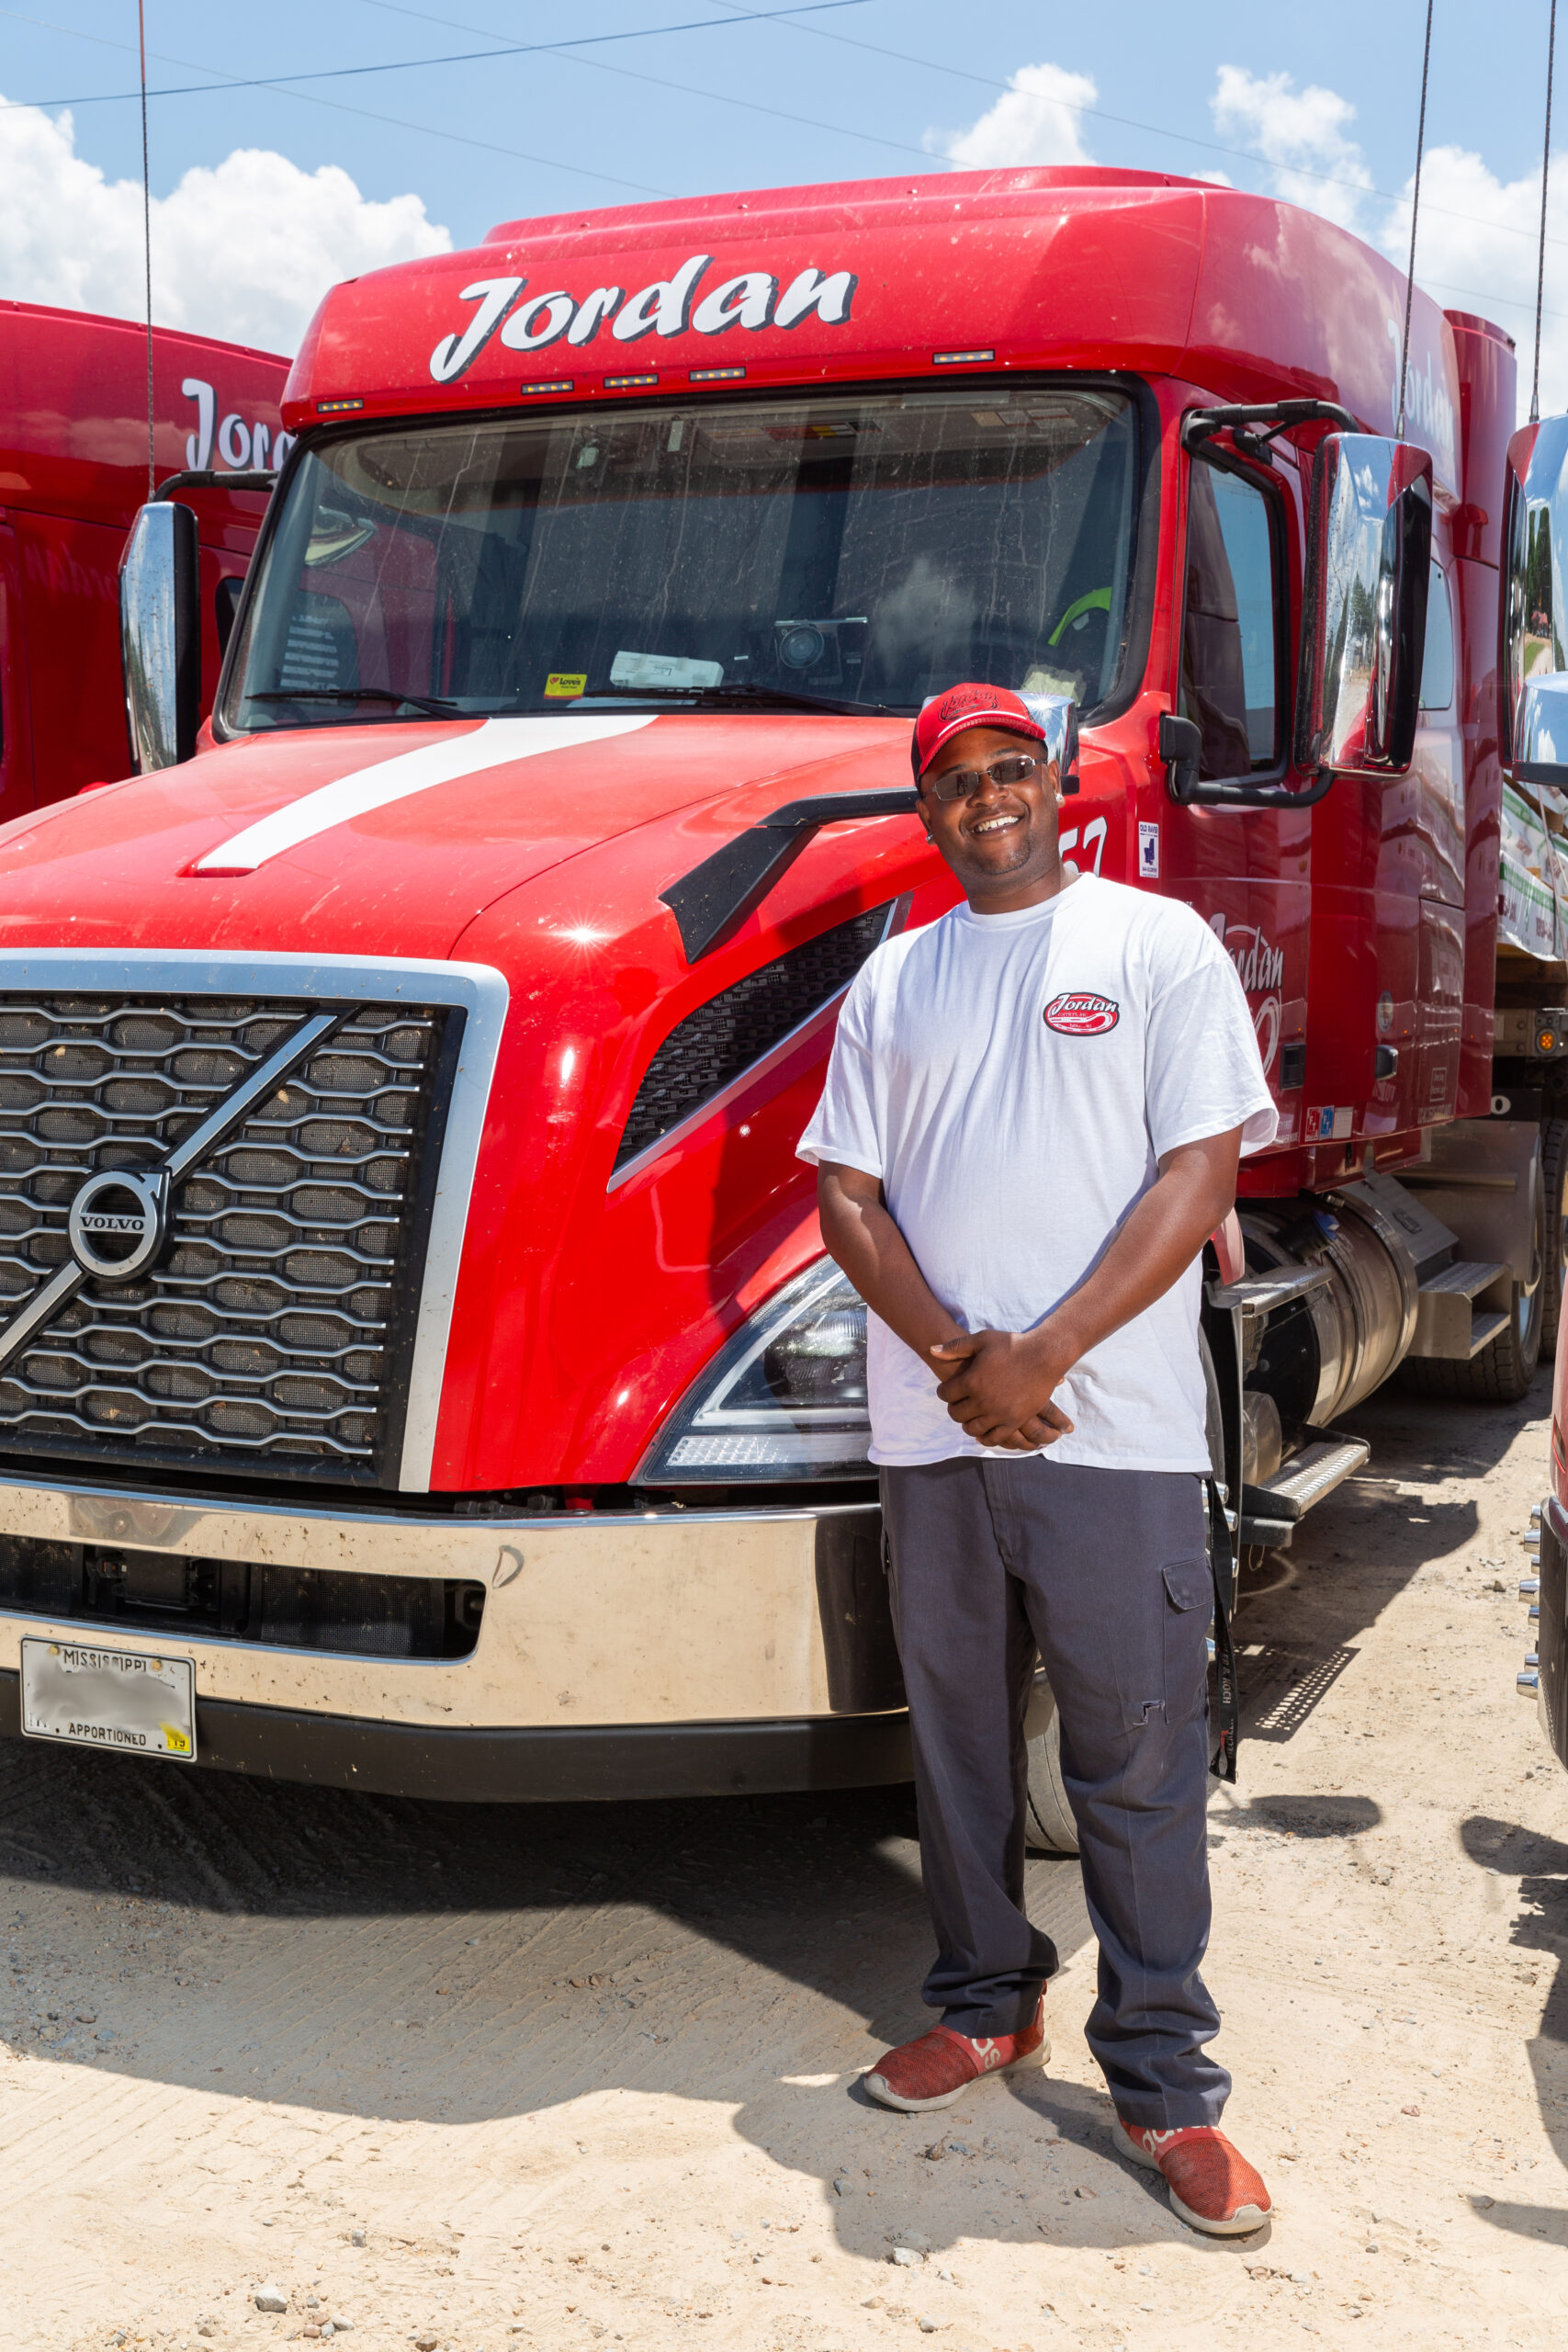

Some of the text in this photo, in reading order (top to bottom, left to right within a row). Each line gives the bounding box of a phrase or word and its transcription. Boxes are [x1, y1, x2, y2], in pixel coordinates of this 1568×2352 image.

[429, 254, 859, 385] Jordan
[1051, 993, 1117, 1016] Jordan
[79, 1216, 145, 1231] VOLVO
[68, 1722, 147, 1747] APPORTIONED
